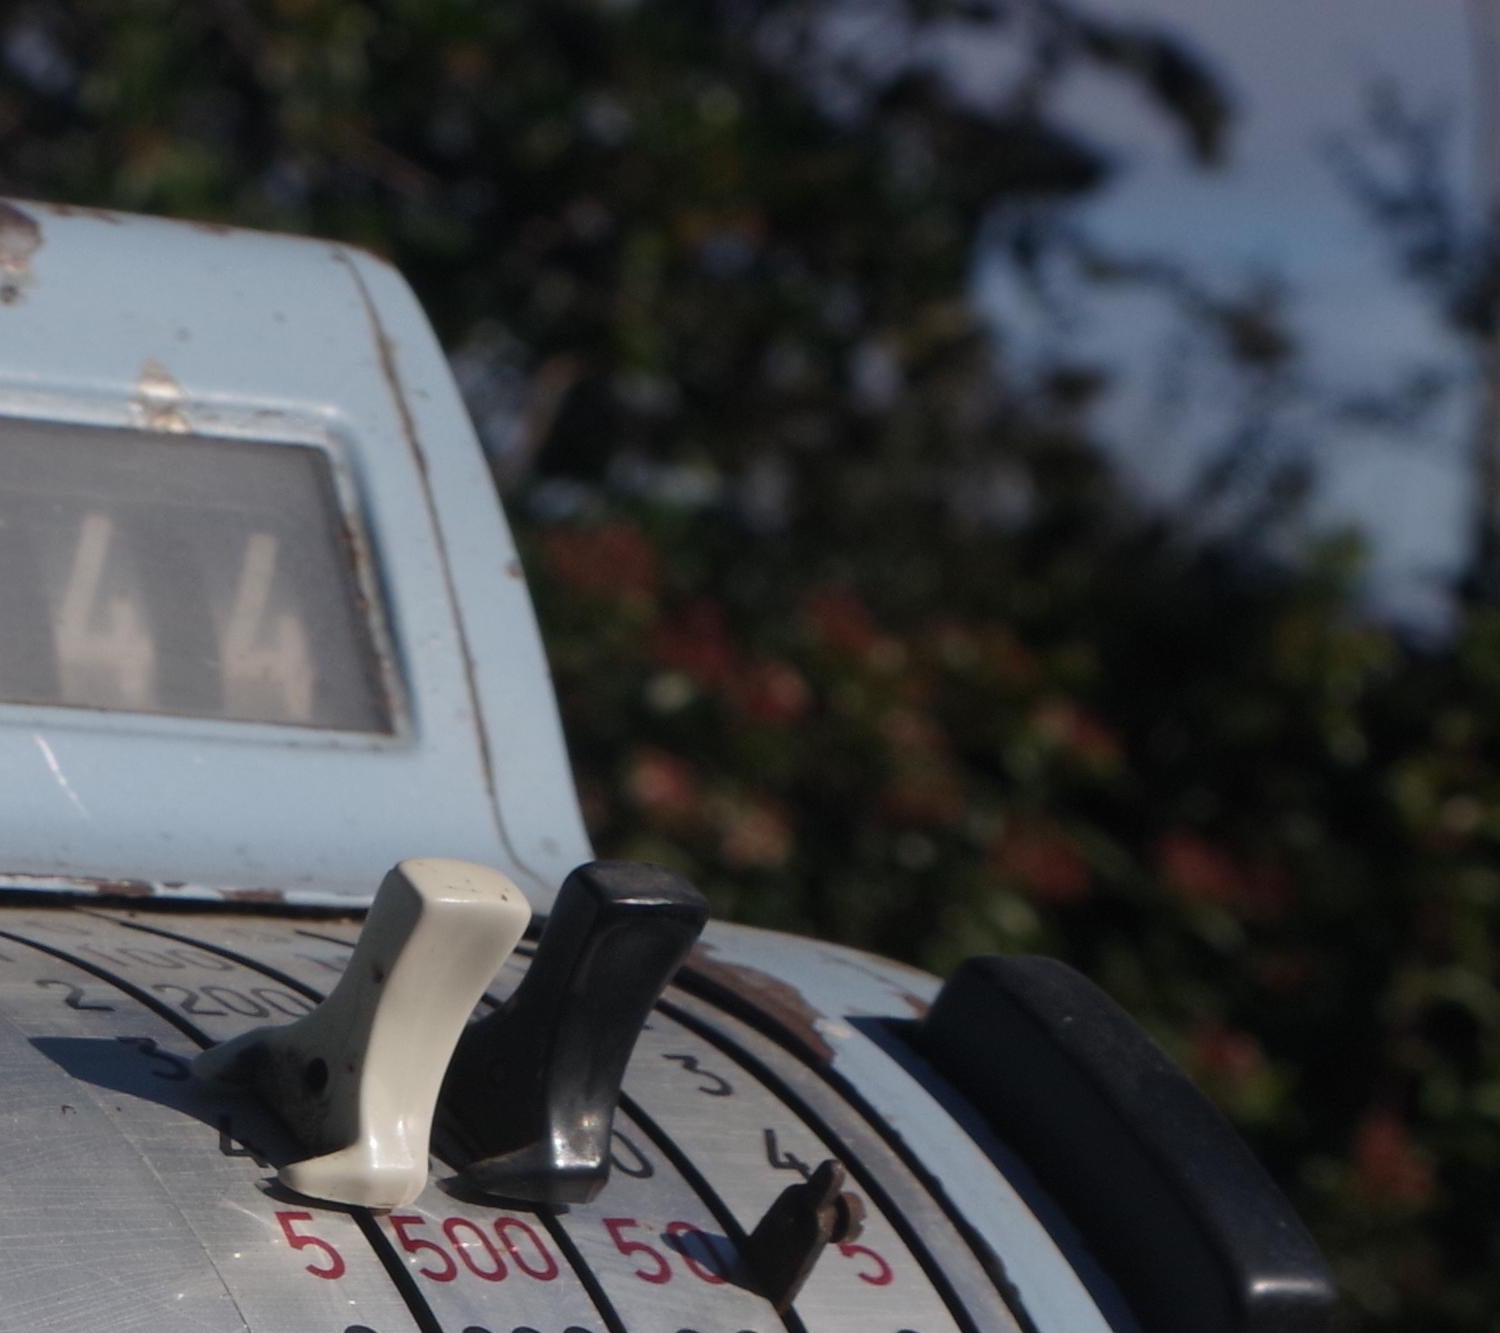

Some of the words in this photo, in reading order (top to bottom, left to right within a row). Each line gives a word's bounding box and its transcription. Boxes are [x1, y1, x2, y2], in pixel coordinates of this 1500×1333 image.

[34, 979, 116, 1012] 2
[150, 984, 316, 1019] 200
[116, 1036, 193, 1082] 3
[662, 1053, 733, 1097] 3
[275, 1211, 346, 1281] 5
[390, 1215, 562, 1283] 500
[602, 1217, 737, 1285] 50
